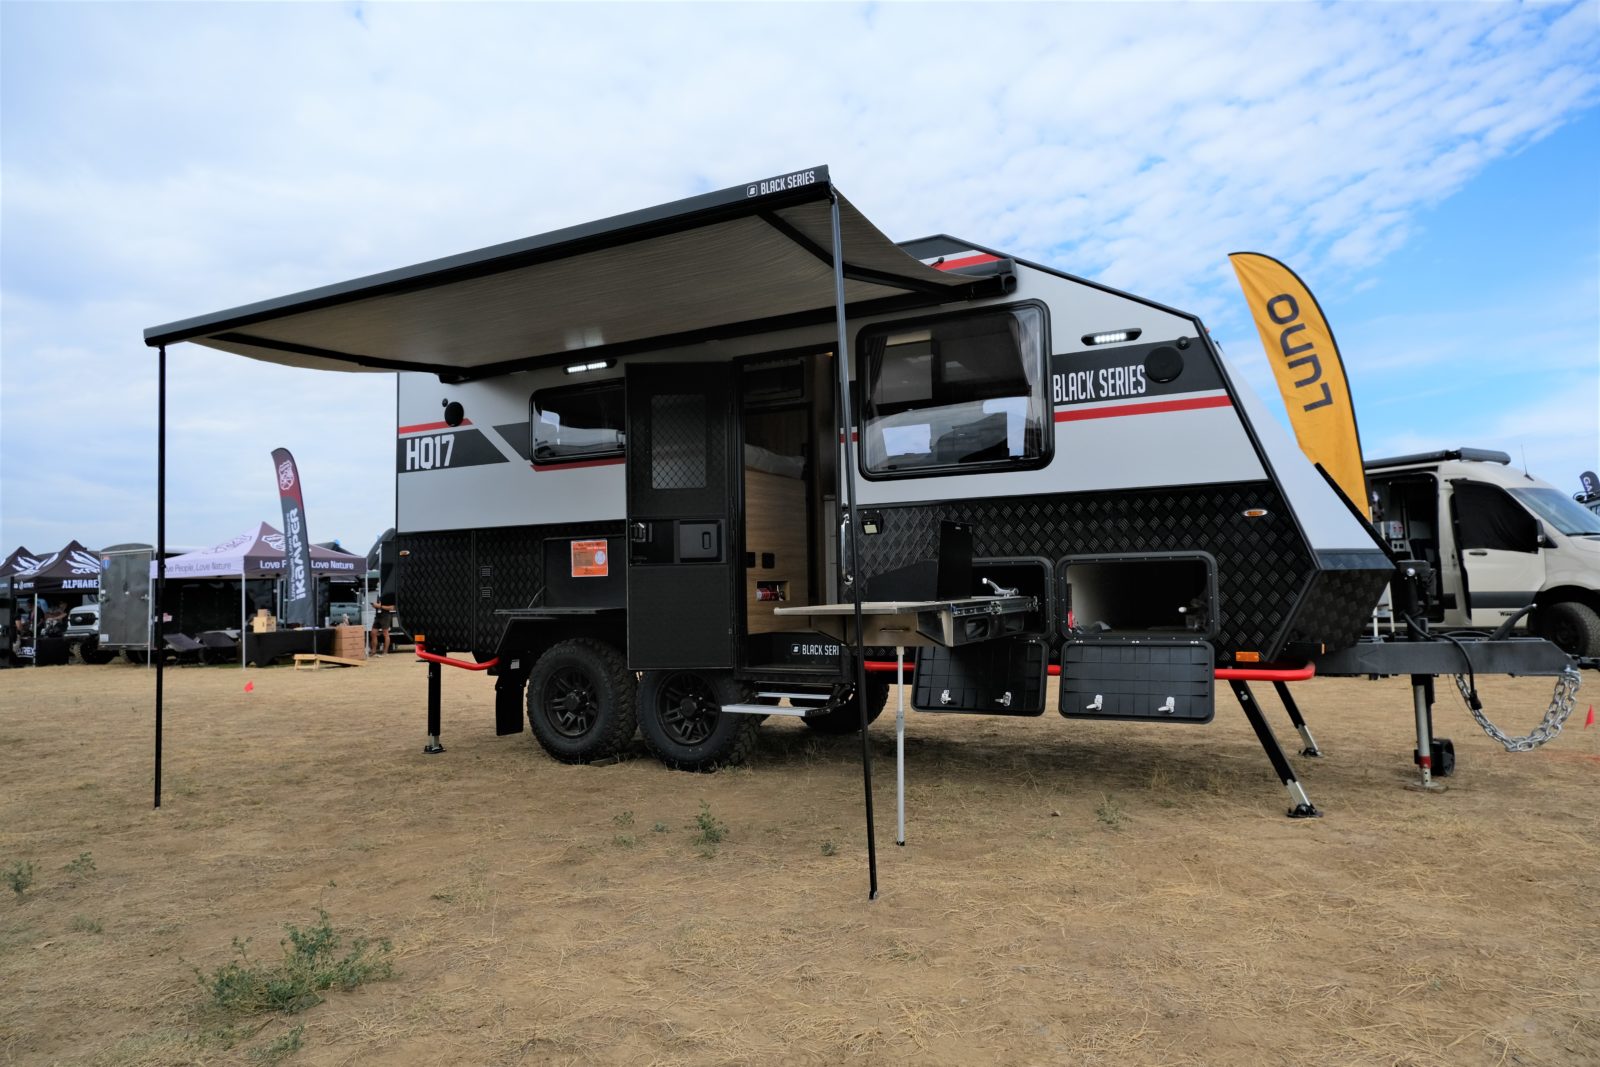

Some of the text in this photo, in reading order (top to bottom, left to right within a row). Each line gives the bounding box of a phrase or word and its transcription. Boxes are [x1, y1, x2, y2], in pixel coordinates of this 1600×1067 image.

[760, 170, 815, 195] BLACK SERIES
[1052, 364, 1146, 403] BLACK SERIES
[406, 433, 455, 470] HQ17
[260, 559, 280, 569] Love
[311, 559, 354, 570] Love Nature
[62, 579, 99, 589] ALPHARE
[802, 644, 840, 656] BLACK SERI
